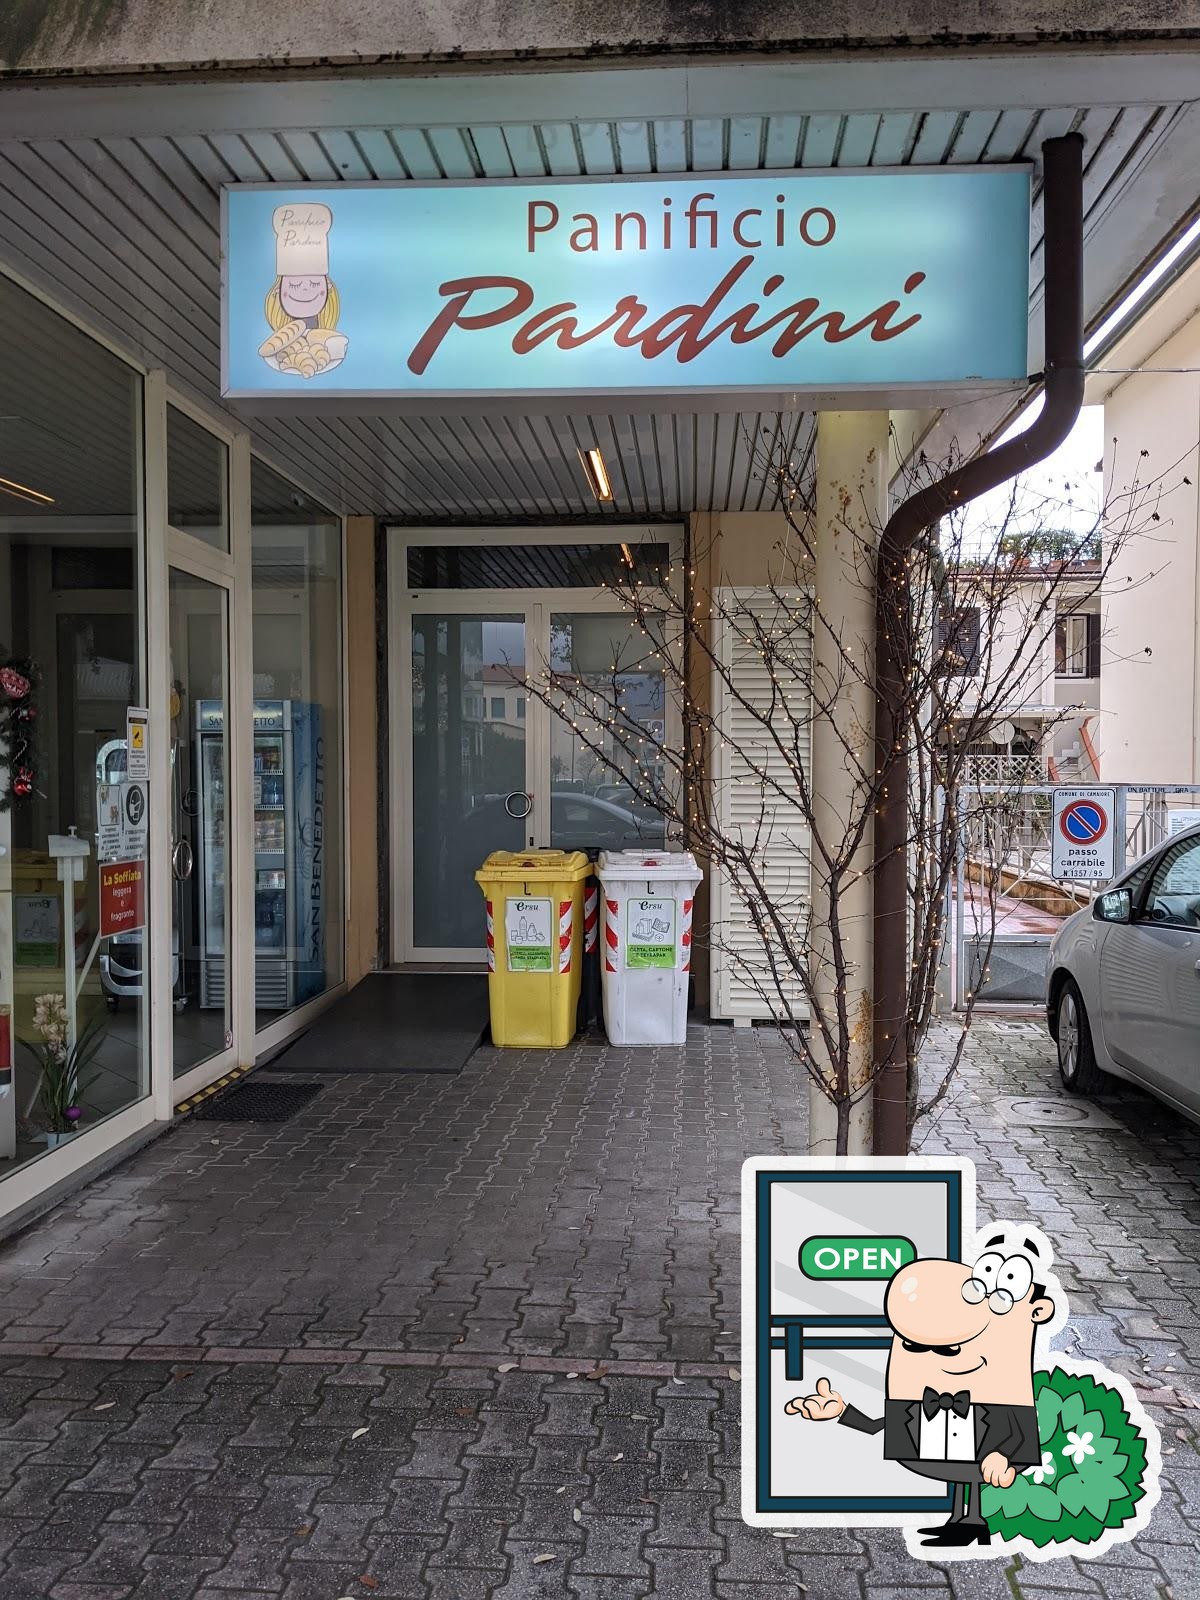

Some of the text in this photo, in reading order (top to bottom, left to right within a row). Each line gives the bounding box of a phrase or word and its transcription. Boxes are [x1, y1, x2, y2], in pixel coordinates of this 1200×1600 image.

[527, 192, 837, 252] Panificio
[407, 254, 926, 376] Pardini
[311, 737, 326, 900] BENEDETTO
[1068, 849, 1098, 857] passo
[1060, 858, 1106, 867] carrabile
[103, 869, 142, 887] La Soffiata
[112, 886, 132, 898] leggera
